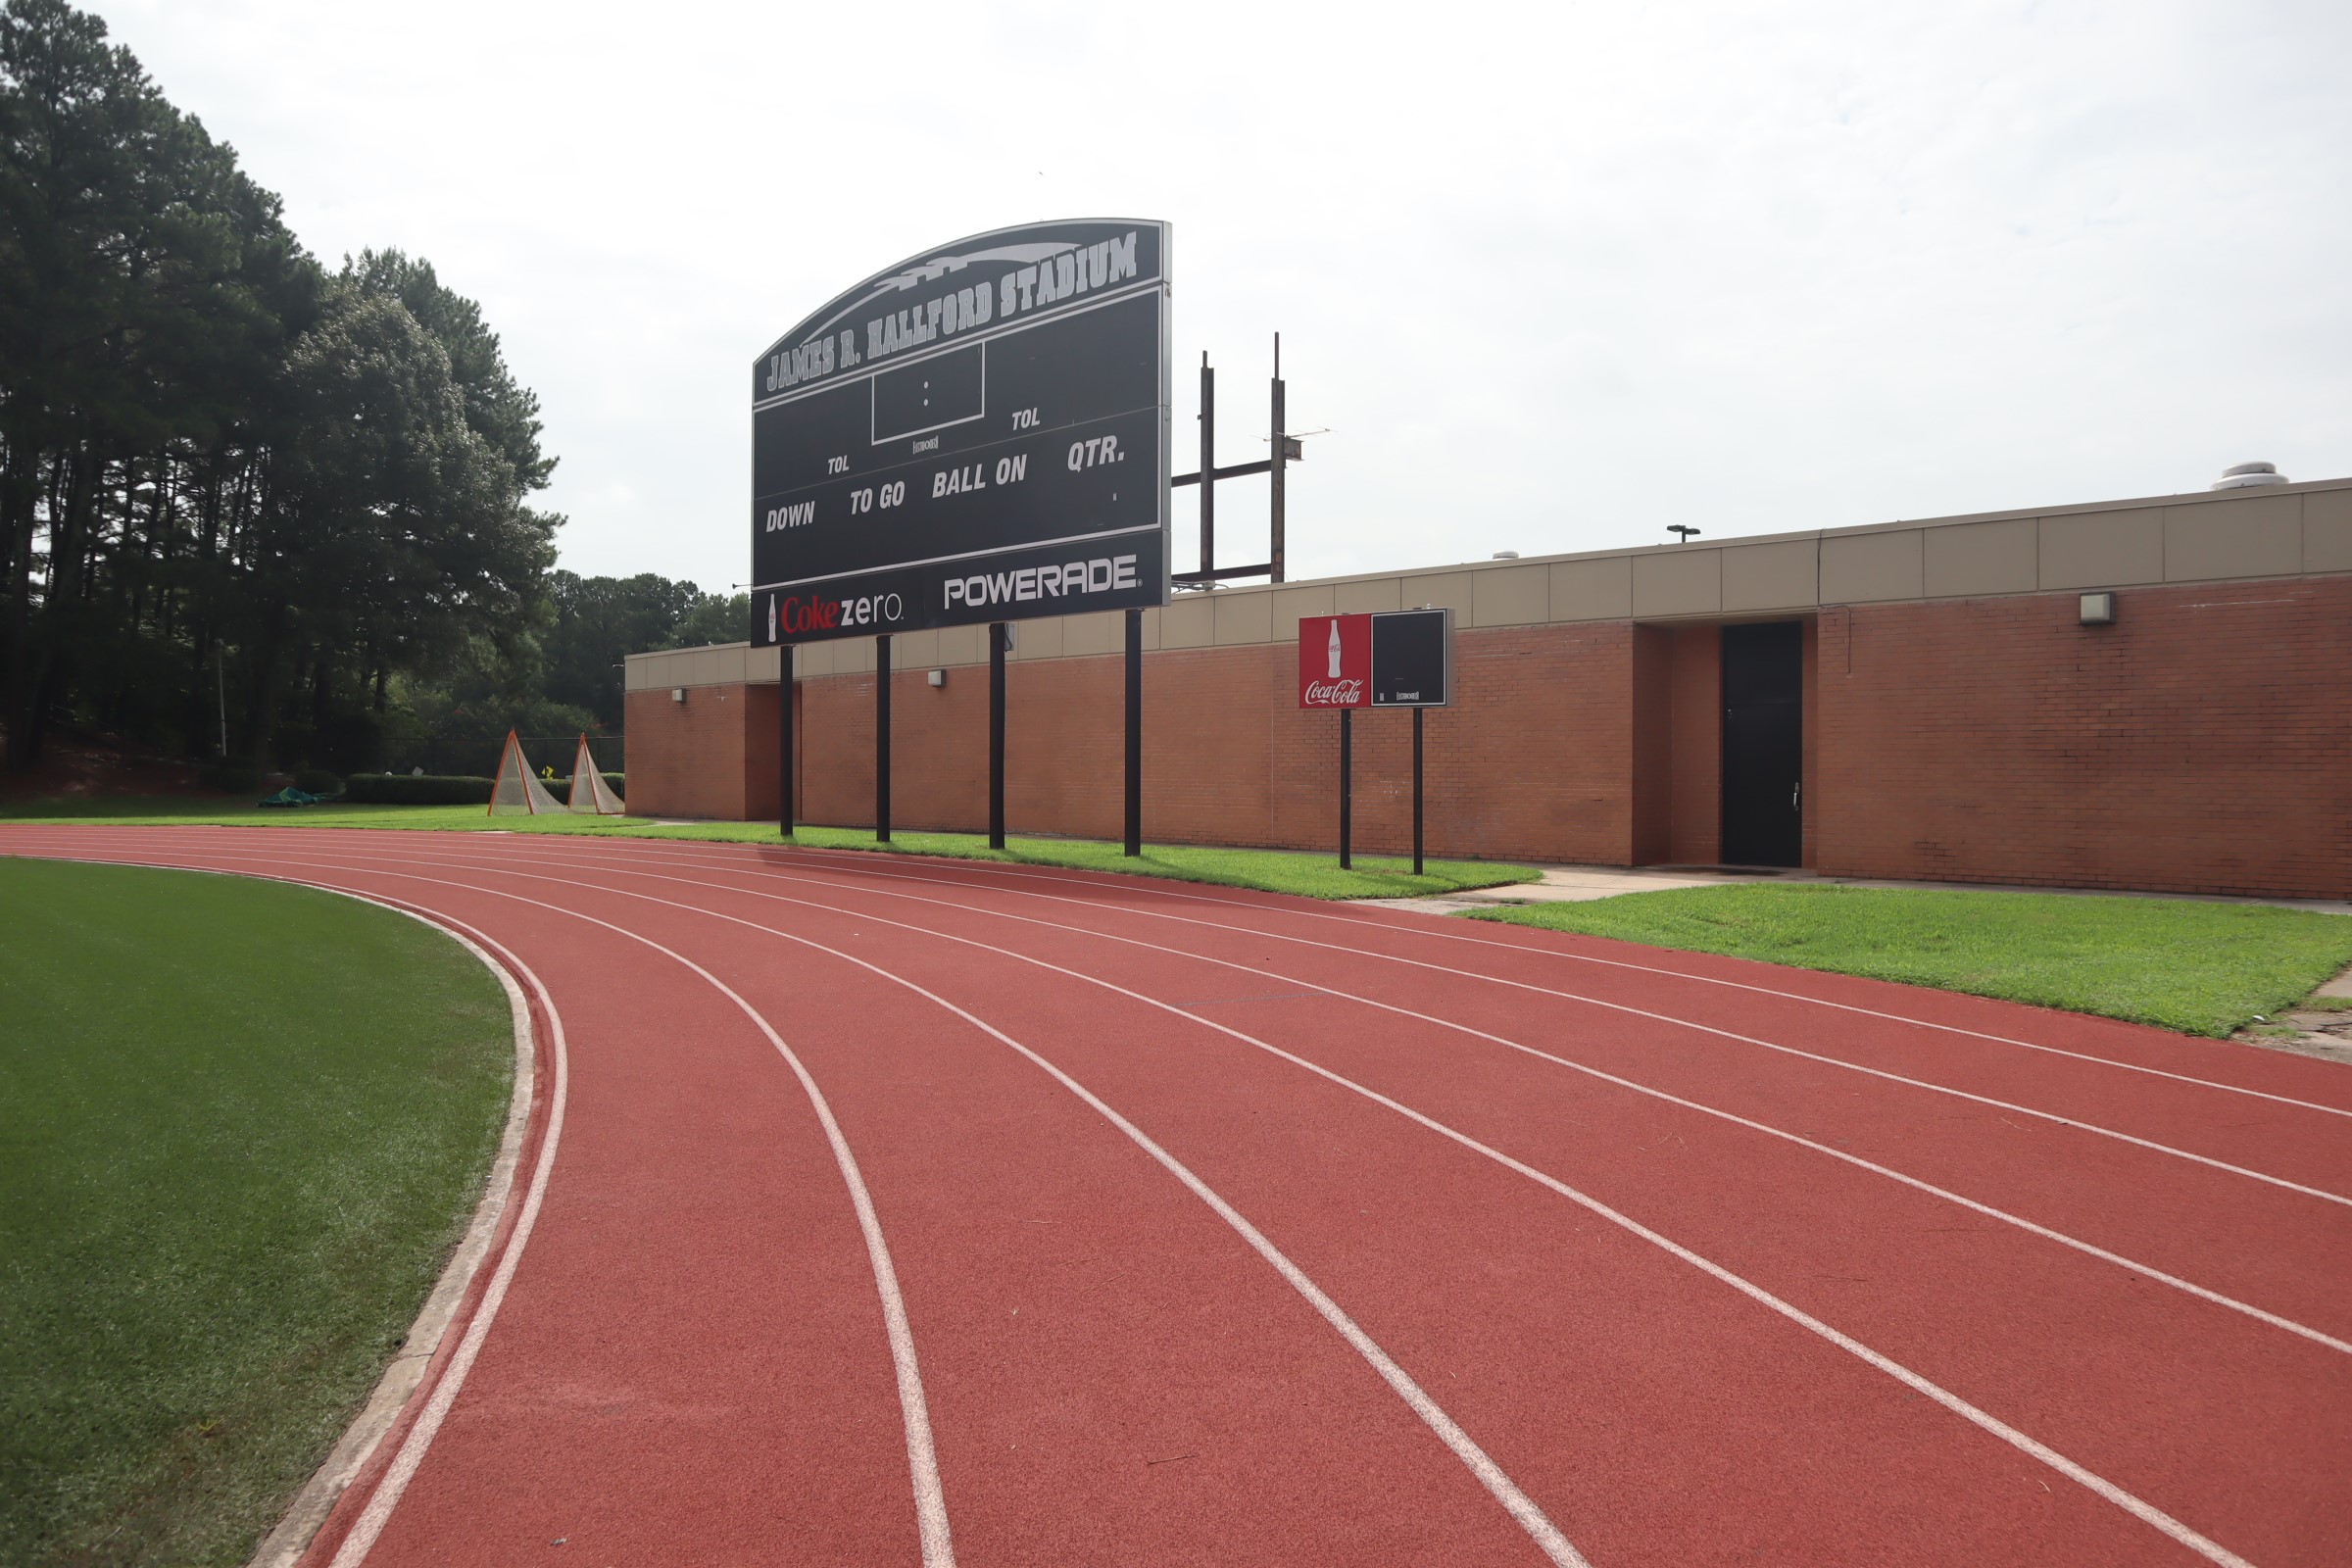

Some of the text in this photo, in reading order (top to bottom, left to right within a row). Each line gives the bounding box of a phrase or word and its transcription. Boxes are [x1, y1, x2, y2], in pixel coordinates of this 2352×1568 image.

[766, 231, 1138, 392] JAMES R. HALLFORD STADIUM
[1011, 408, 1041, 431] TOL
[827, 455, 850, 475] TOL
[1067, 434, 1125, 472] QTR.
[932, 454, 1027, 499] BALL ON
[850, 480, 906, 514] TO GO
[765, 501, 815, 533] DOWN
[944, 554, 1138, 610] POWERADE
[1305, 679, 1363, 705] Coca-Cola
